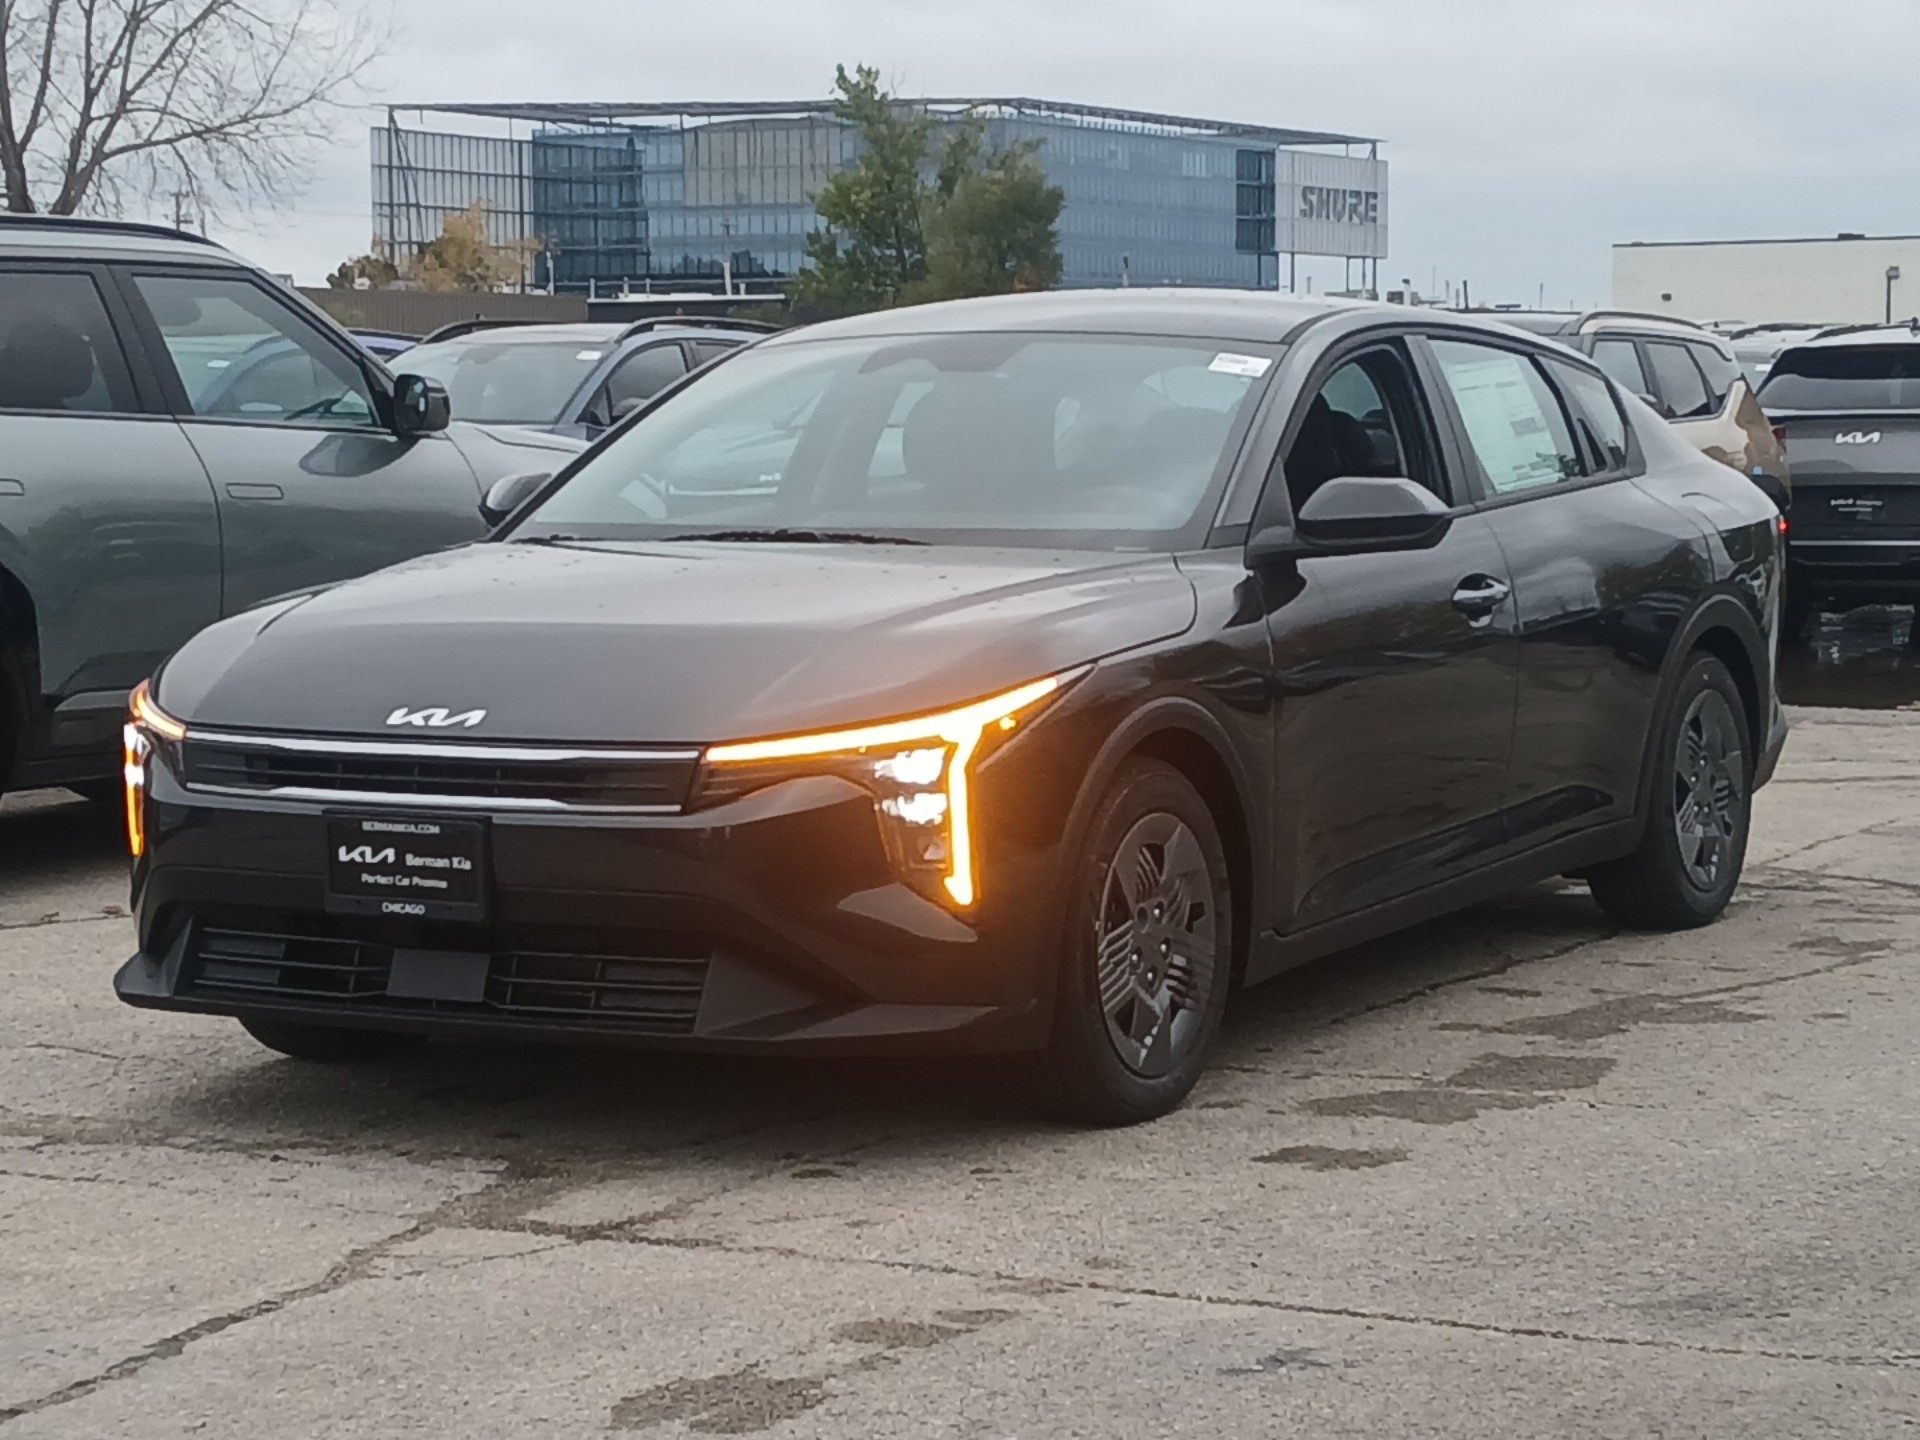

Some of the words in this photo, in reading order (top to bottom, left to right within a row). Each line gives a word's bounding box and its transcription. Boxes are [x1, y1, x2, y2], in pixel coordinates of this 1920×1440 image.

[1300, 186, 1378, 226] SHURE
[1835, 431, 1881, 444] KIA
[385, 707, 487, 728] KIA
[338, 845, 396, 864] KIA
[452, 856, 472, 870] Kia
[382, 901, 426, 915] CHICAGO
